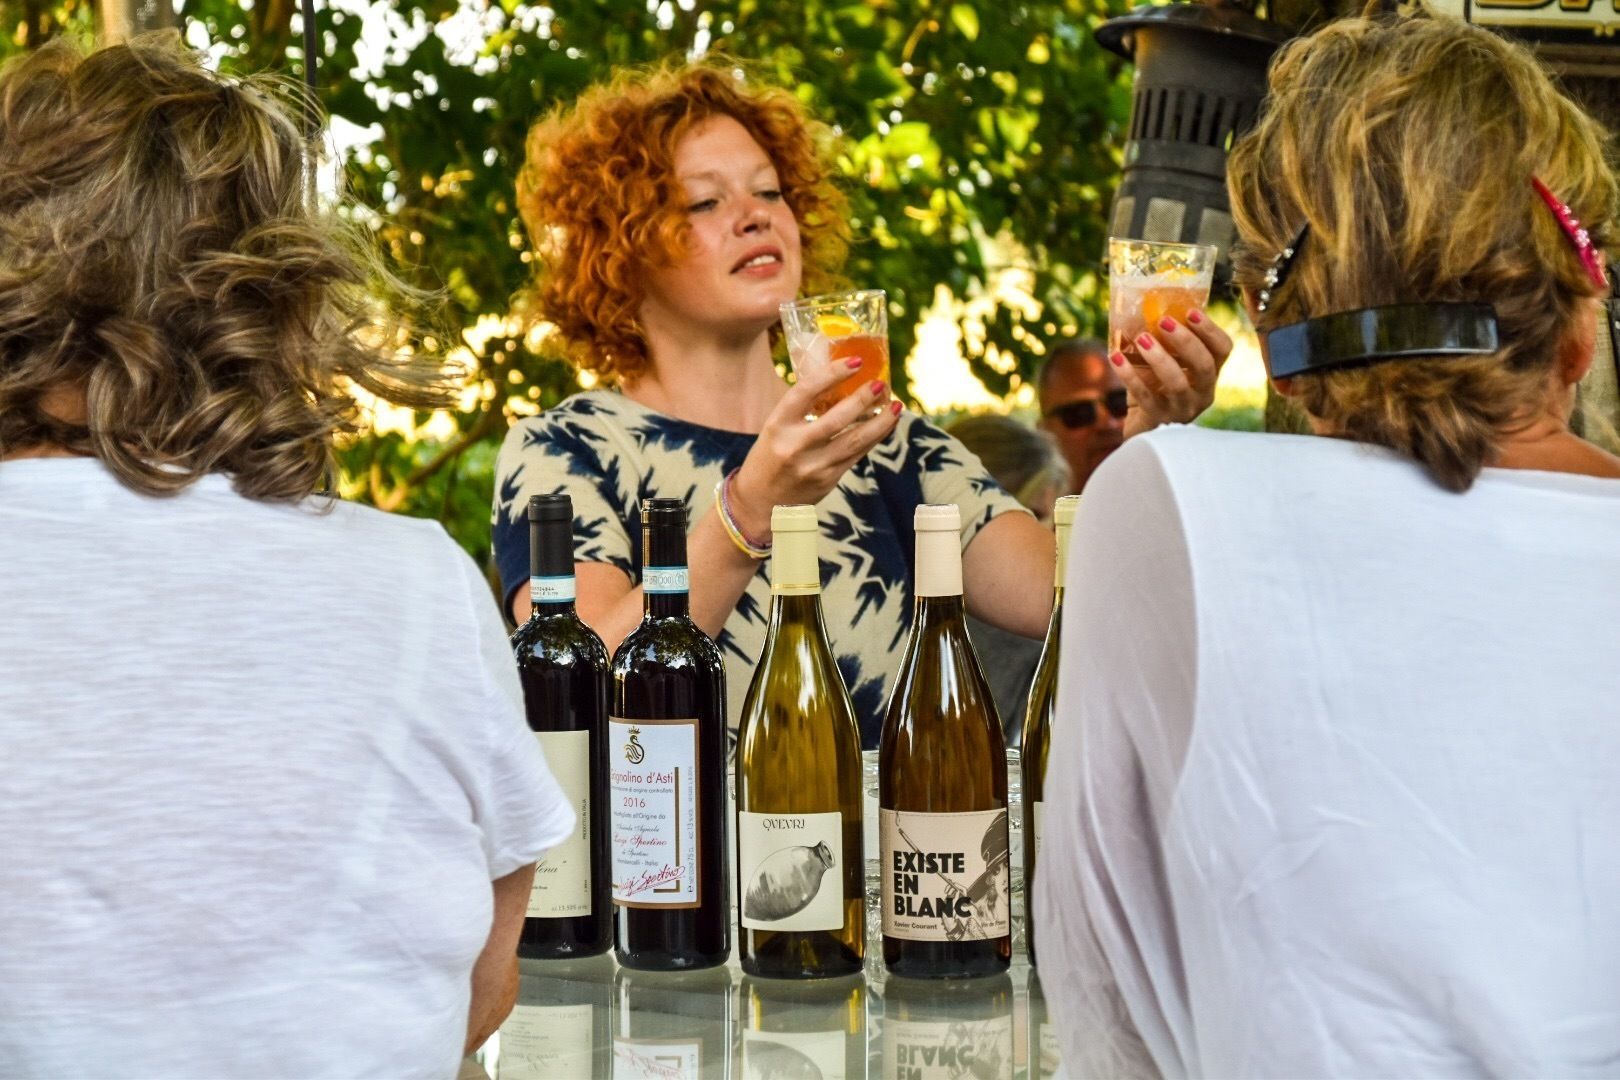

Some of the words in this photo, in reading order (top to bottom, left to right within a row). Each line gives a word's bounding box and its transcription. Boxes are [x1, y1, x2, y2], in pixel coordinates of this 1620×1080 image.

[646, 771, 673, 784] d'Asti
[623, 797, 646, 808] 2016
[893, 850, 965, 874] EXISTE
[893, 873, 919, 895] EN
[893, 895, 972, 918] BLANC
[911, 921, 938, 930] Courant
